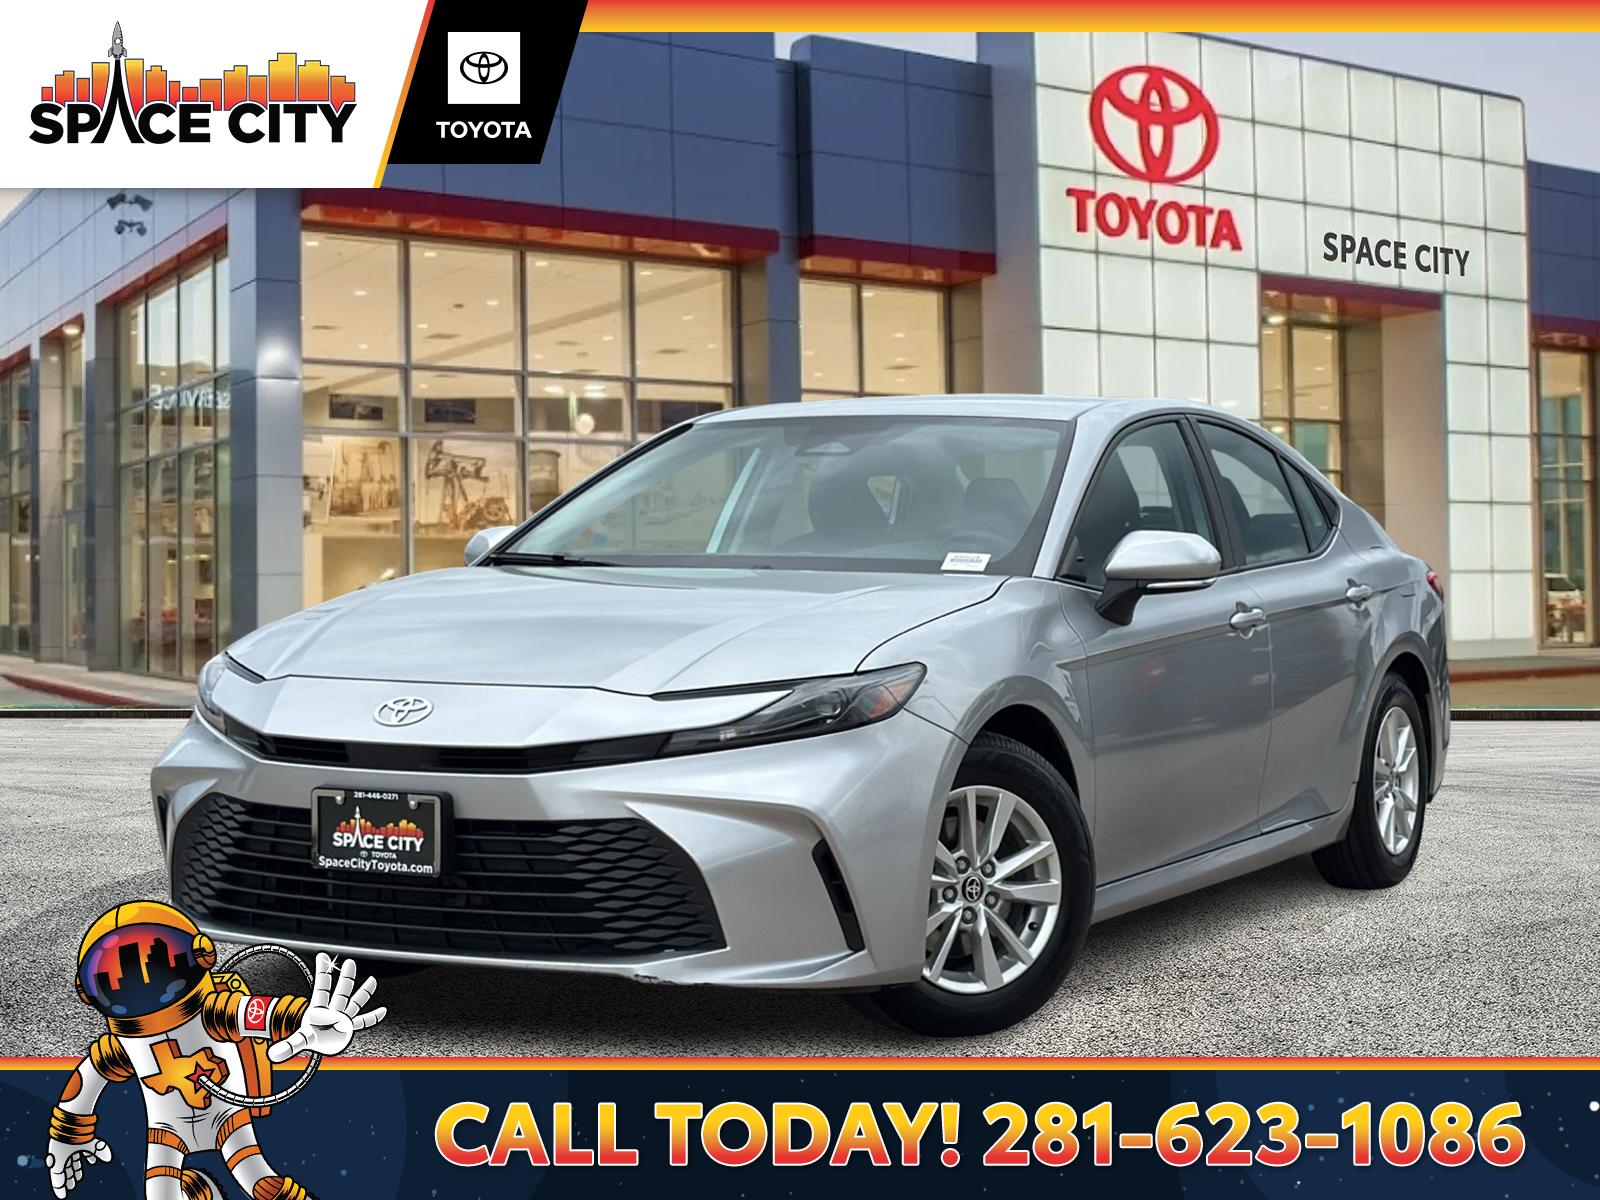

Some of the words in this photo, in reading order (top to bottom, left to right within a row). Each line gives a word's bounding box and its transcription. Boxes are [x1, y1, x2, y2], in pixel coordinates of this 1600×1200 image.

[1065, 188, 1242, 251] TOYOTA
[1322, 231, 1408, 271] SPACE
[1414, 244, 1471, 278] CITY
[332, 831, 384, 849] SPACE
[387, 835, 424, 852] CITY
[318, 855, 433, 874] SpaceCityToyota.com
[371, 851, 397, 859] TOYOTA
